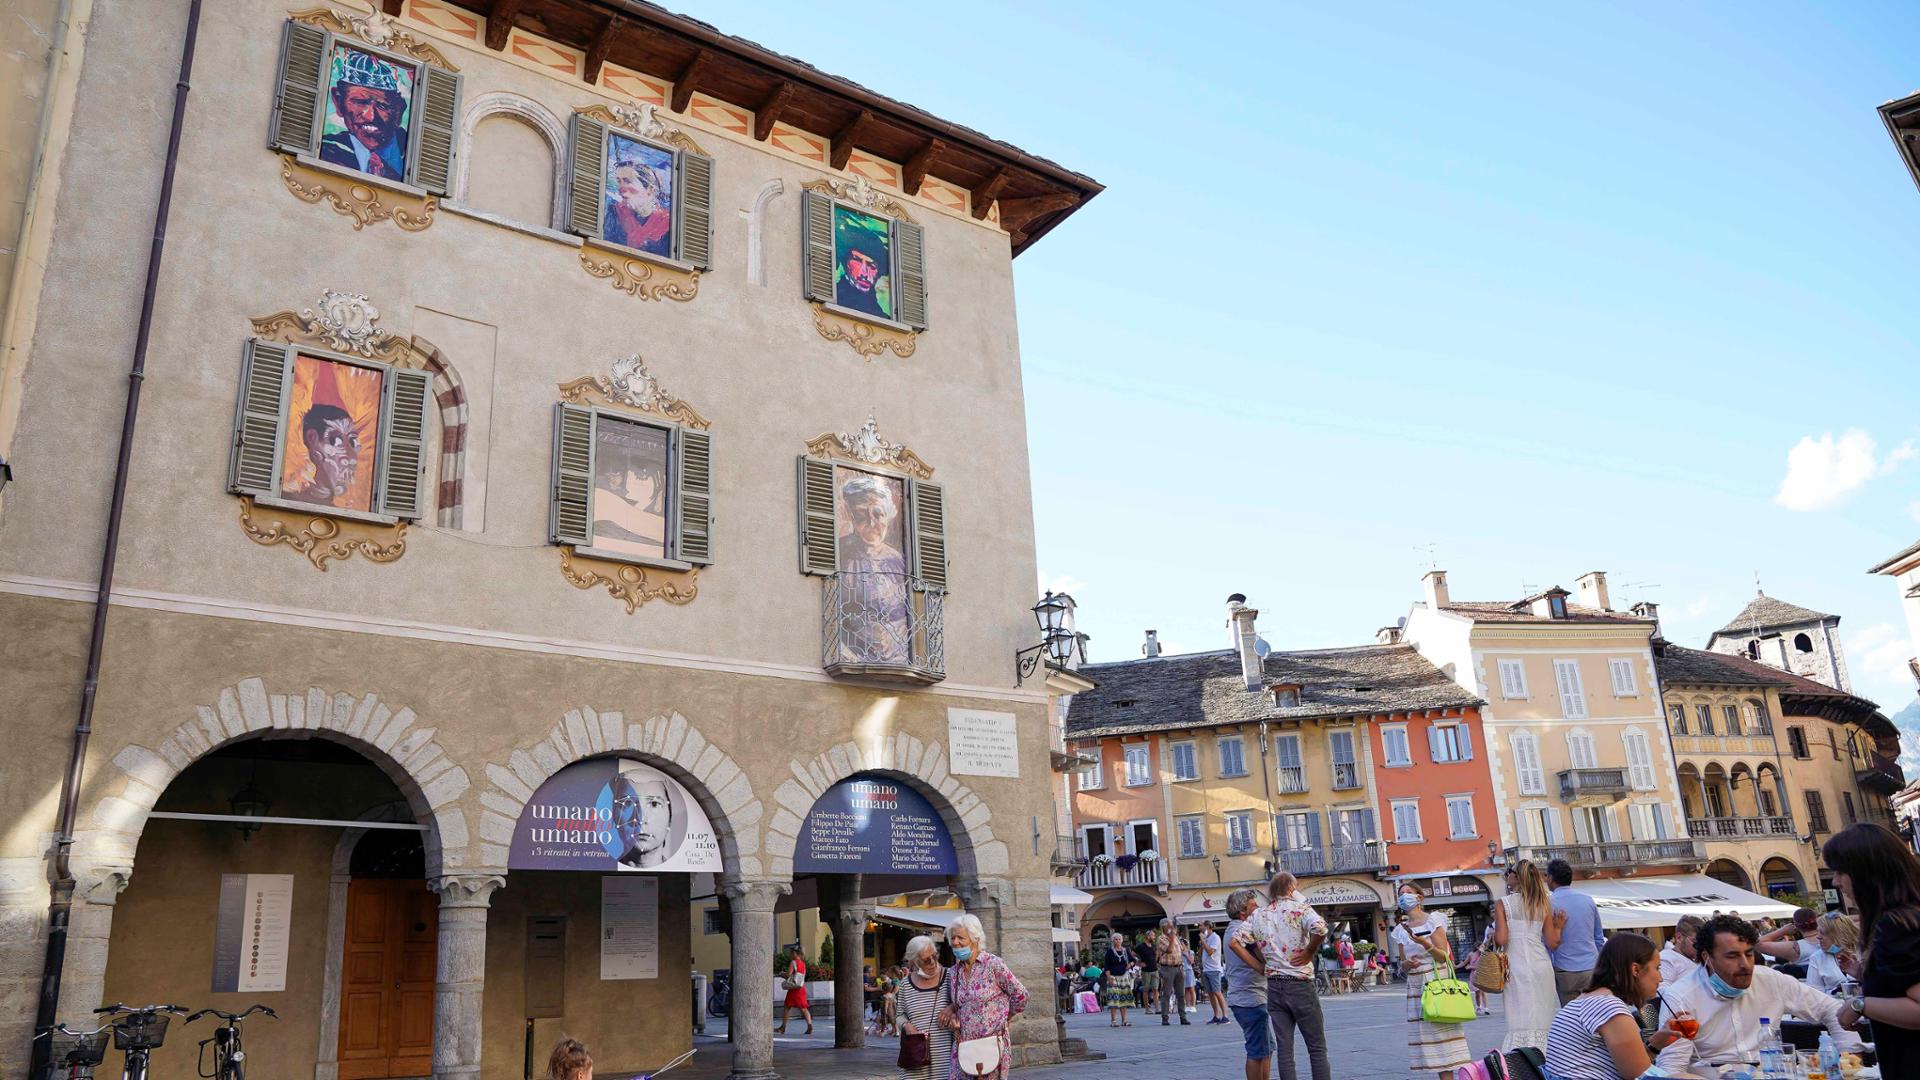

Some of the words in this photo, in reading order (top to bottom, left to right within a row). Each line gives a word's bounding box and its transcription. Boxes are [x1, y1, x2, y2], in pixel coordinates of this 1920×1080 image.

[851, 783, 898, 795] umano
[851, 799, 898, 810] umano
[531, 804, 613, 822] umano
[811, 810, 839, 820] Umberto
[555, 811, 611, 832] molto
[890, 814, 907, 823] Carlo
[811, 819, 834, 830] Filippo
[530, 827, 613, 845] umano
[687, 833, 709, 843] 11.07
[811, 828, 831, 838] Beppe
[832, 828, 855, 836] Devalle
[907, 831, 934, 839] Mondino
[695, 842, 716, 850] 11.10
[891, 838, 914, 846] Barbara
[531, 847, 542, 856] 13
[543, 848, 570, 857] ritratti
[572, 848, 580, 857] in
[583, 849, 610, 858] vetrina
[811, 843, 847, 851] Gianfranco
[847, 844, 870, 852] Ferroni
[811, 851, 838, 859] Giosetta
[910, 854, 936, 862] Schifano
[891, 861, 919, 869] Giovanni
[919, 862, 941, 870] Testori
[1336, 894, 1376, 902] KAMARES
